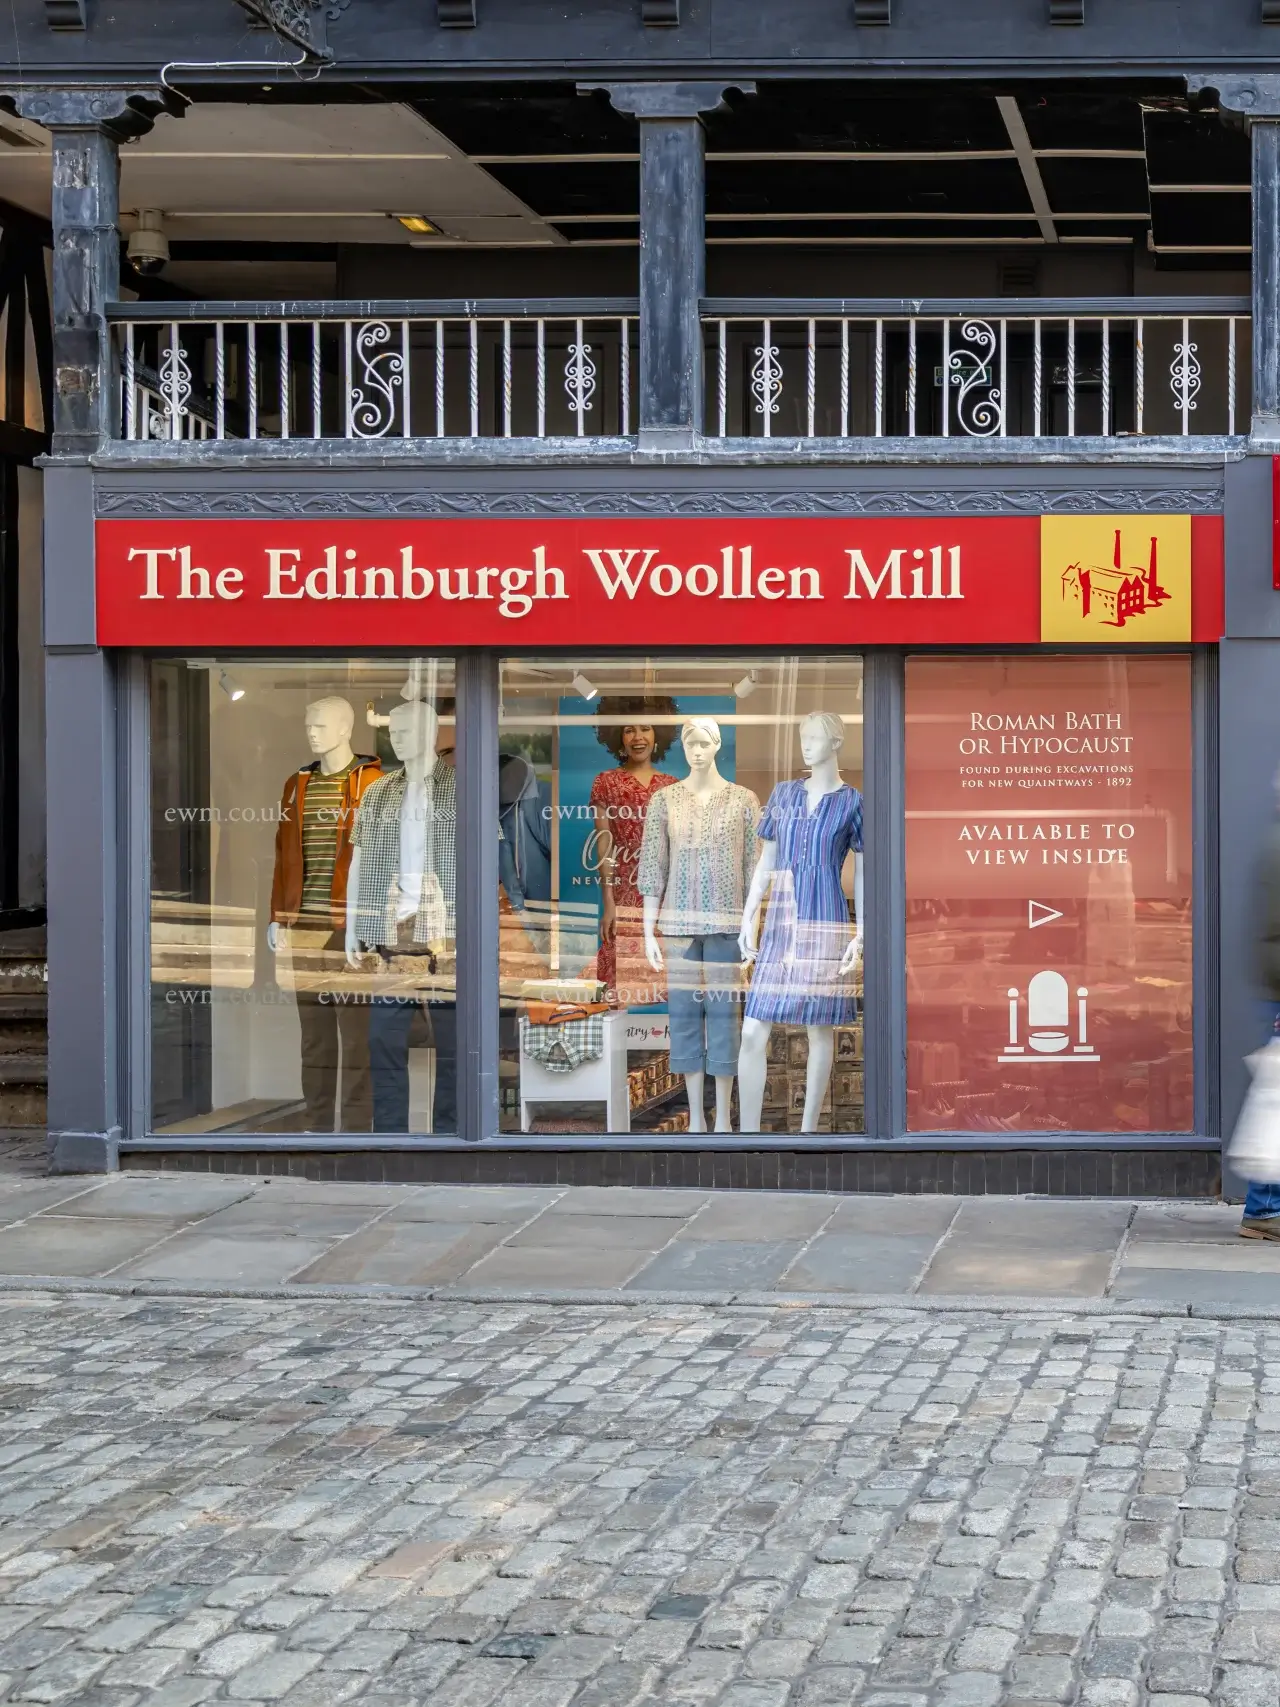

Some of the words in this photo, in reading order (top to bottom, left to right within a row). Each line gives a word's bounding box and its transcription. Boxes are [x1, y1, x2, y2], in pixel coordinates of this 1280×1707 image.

[127, 545, 244, 600] The
[262, 545, 570, 618] Edinburgh
[581, 545, 825, 600] Woollen
[843, 545, 966, 600] Mill
[959, 766, 1000, 775] FOUND
[1005, 766, 1052, 775] DURING
[1056, 765, 1134, 774] EXCAVATIONS
[961, 779, 984, 788] FOR
[988, 779, 1014, 788] NEW
[1018, 778, 1093, 789] QUAINTWAYS
[1106, 777, 1132, 787] 1892
[164, 800, 292, 822] ewm.co.uk
[541, 801, 650, 820] ewm.co.u
[958, 825, 1090, 841] AVAILABLE
[1102, 824, 1135, 839] TO
[966, 850, 1029, 865] VIEW
[1042, 848, 1128, 864] INSIDE
[572, 876, 622, 885] NEVER
[318, 982, 446, 1004] ewm.co.uk
